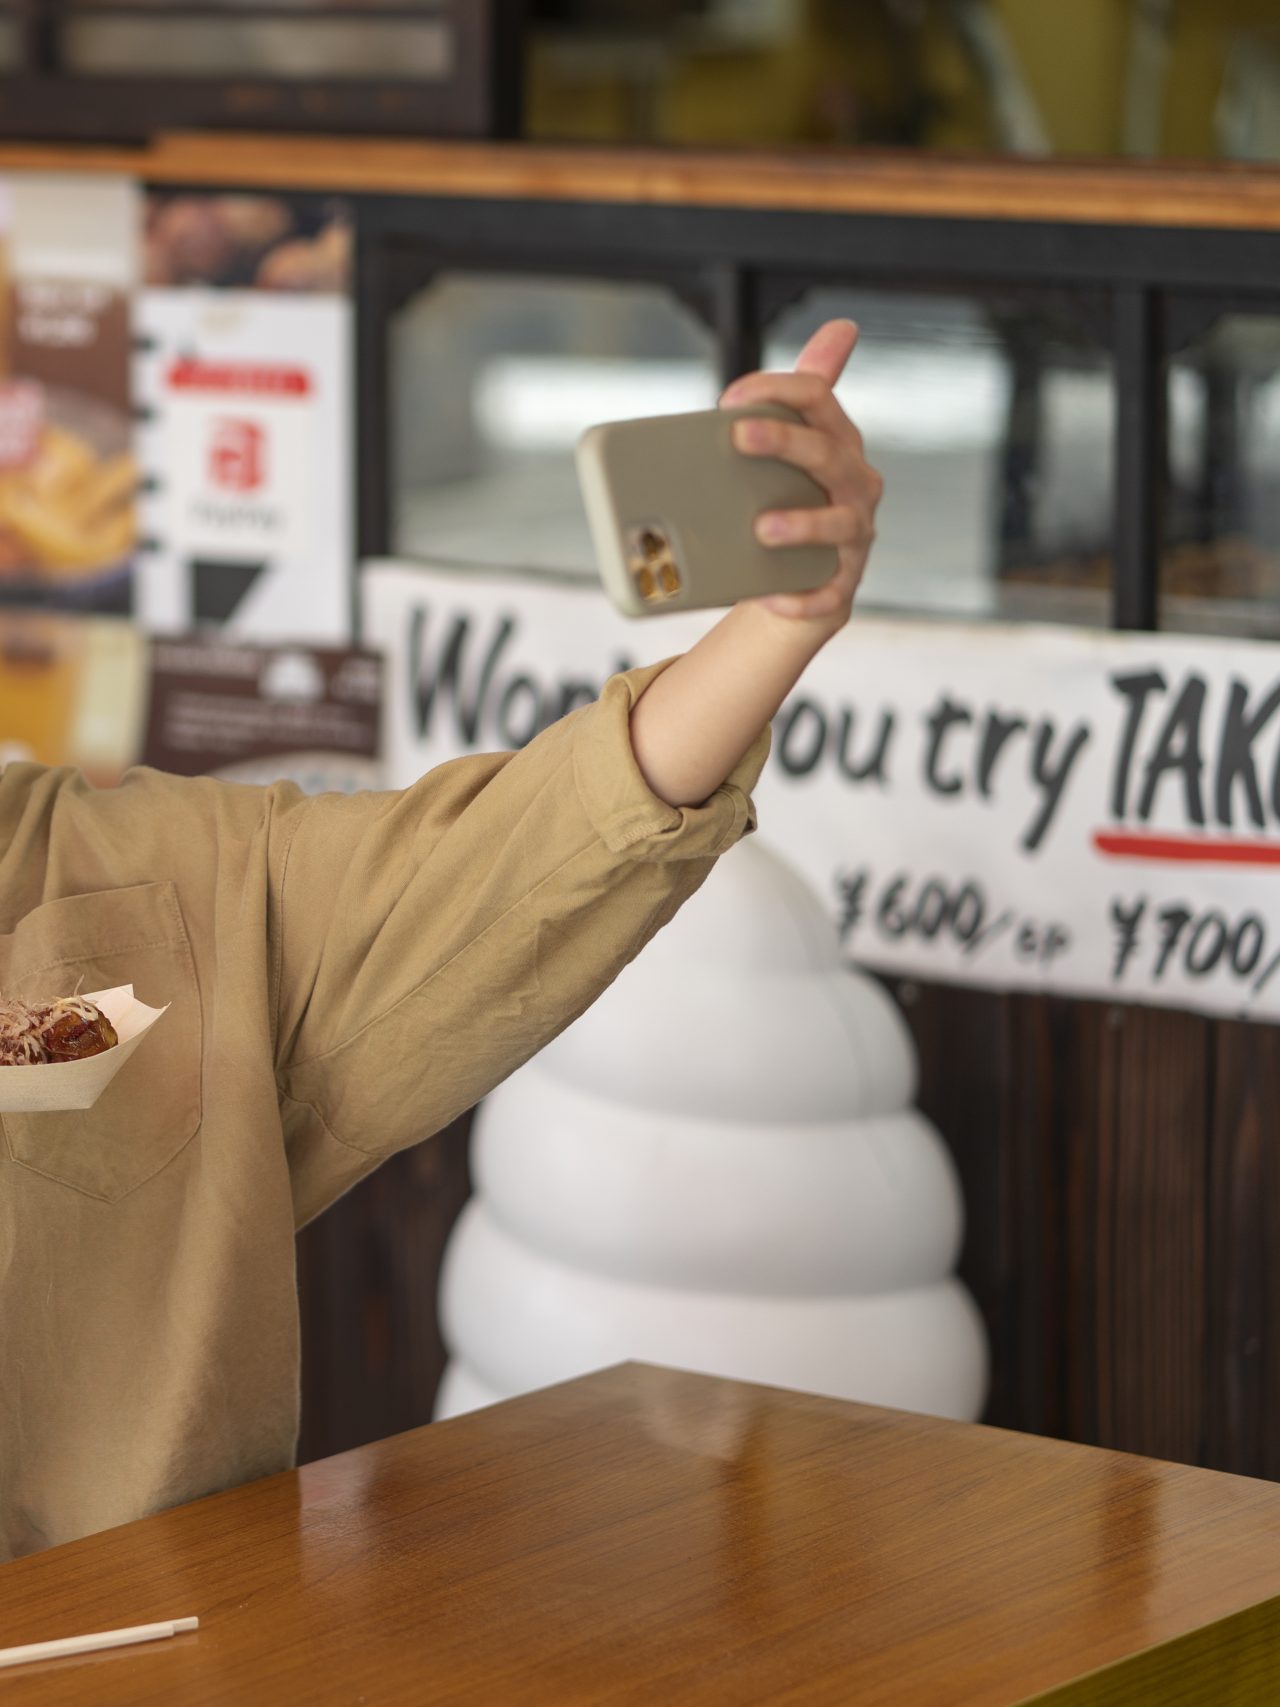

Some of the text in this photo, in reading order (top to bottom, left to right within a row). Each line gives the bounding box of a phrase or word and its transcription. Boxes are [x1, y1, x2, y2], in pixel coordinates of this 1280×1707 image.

[773, 697, 893, 784] ou
[924, 694, 1091, 851] try
[1110, 672, 1280, 826] TAK
